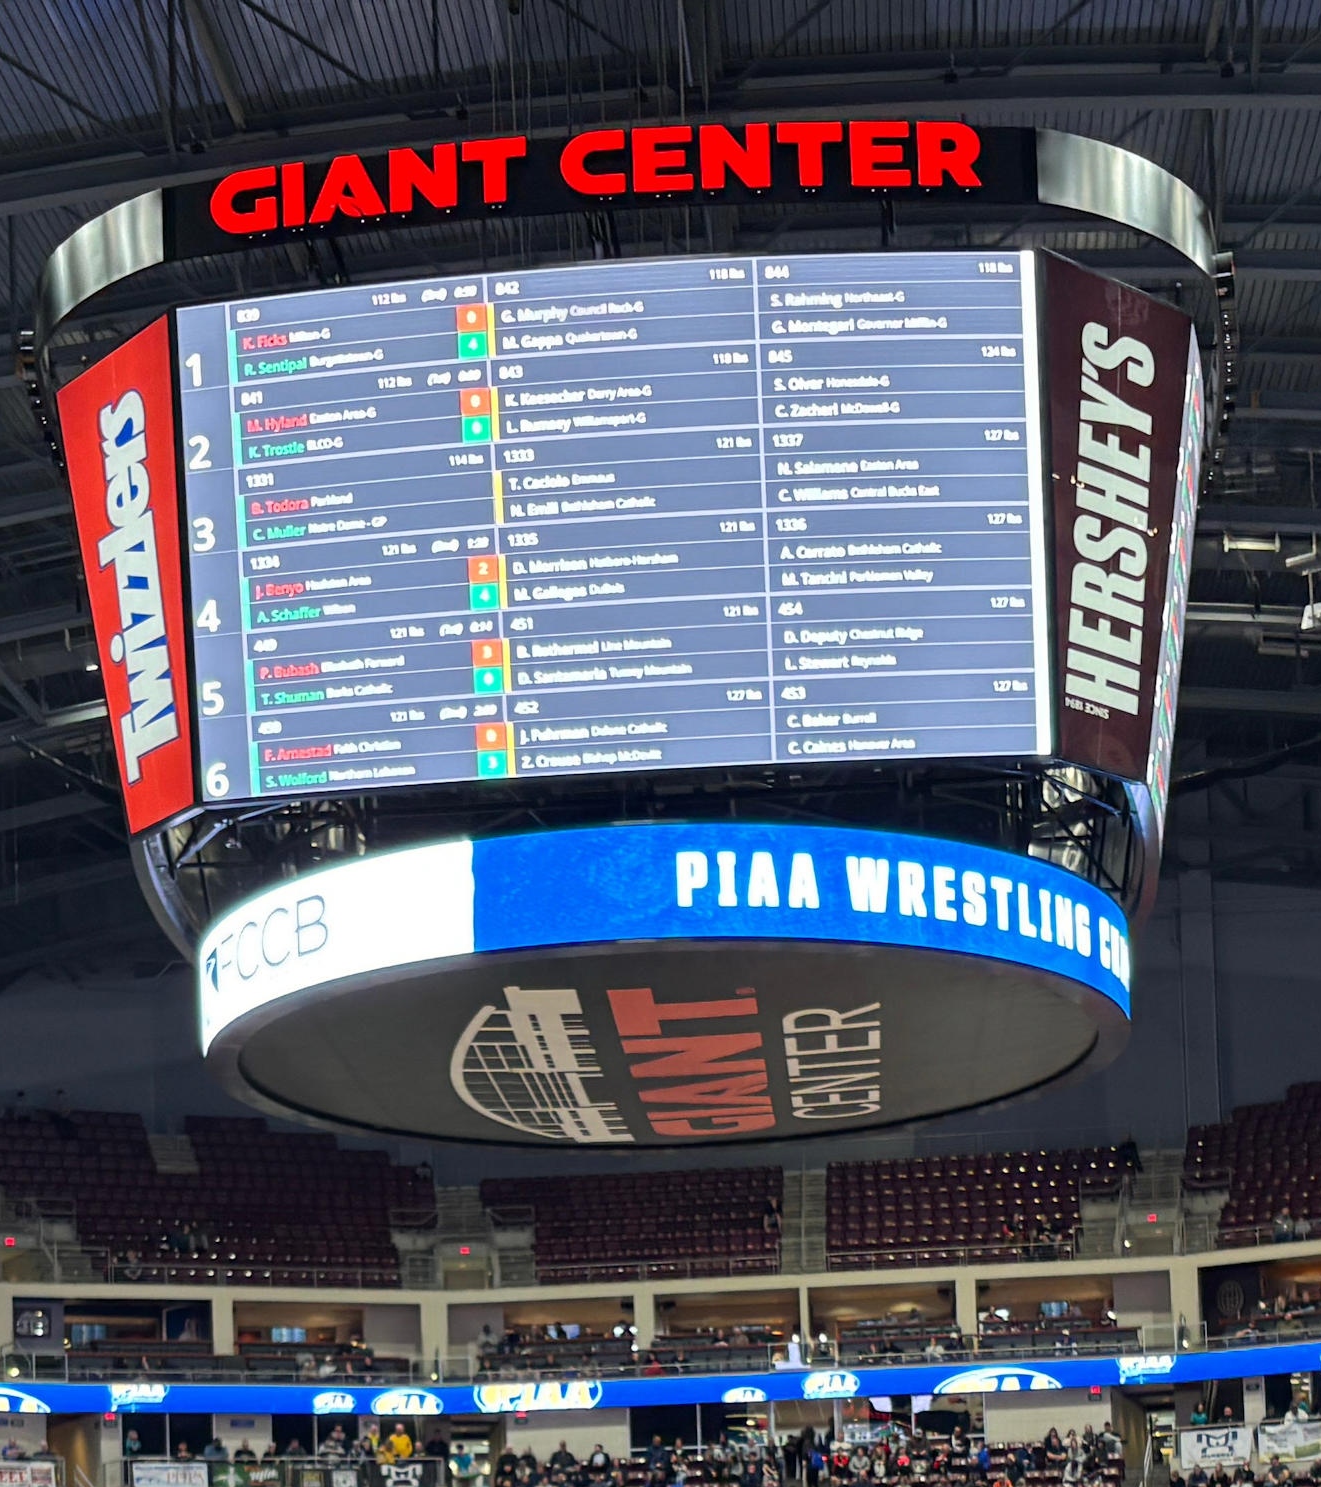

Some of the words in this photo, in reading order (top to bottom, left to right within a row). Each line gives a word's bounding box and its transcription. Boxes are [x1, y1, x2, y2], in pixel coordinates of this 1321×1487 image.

[210, 136, 528, 237] GIANT
[560, 120, 982, 198] CENTER
[186, 354, 203, 387] 1
[265, 415, 307, 432] Hyland
[189, 435, 212, 469] 2
[508, 477, 521, 490] T.
[266, 498, 309, 513] Todora
[1065, 321, 1155, 716] HERSHEY'S
[192, 517, 216, 552] 3
[479, 563, 489, 575] 2
[780, 546, 794, 559] A.
[98, 389, 180, 786] Twizzlers
[196, 599, 221, 632] 4
[202, 681, 224, 715] 5
[262, 694, 273, 705] T.
[274, 689, 324, 704] Shuman
[206, 763, 229, 796] 6
[679, 852, 818, 911] PIAA
[846, 856, 1093, 959] WRESTLING
[218, 897, 329, 983] FCCB
[609, 987, 776, 1136] GIANT
[784, 1002, 881, 1120] CENTER
[477, 1382, 601, 1411] PIAA
